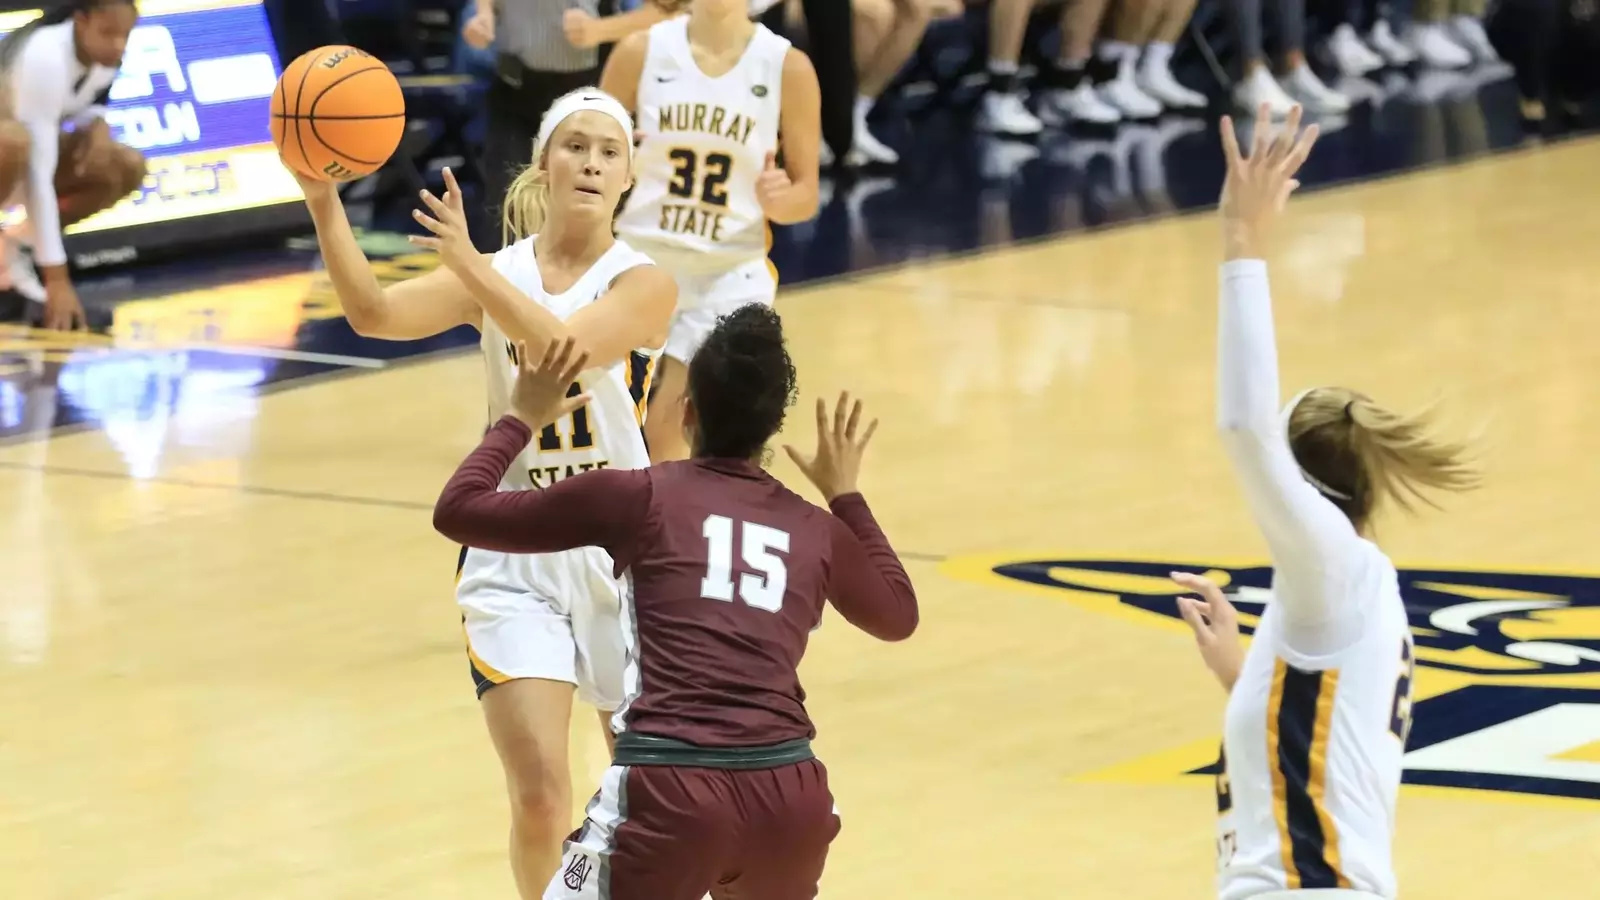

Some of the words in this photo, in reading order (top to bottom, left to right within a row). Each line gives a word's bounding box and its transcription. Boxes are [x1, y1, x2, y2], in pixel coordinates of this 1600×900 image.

[659, 103, 756, 146] MURRAY
[666, 145, 733, 207] 32
[659, 204, 723, 242] STATE
[700, 513, 790, 614] 15
